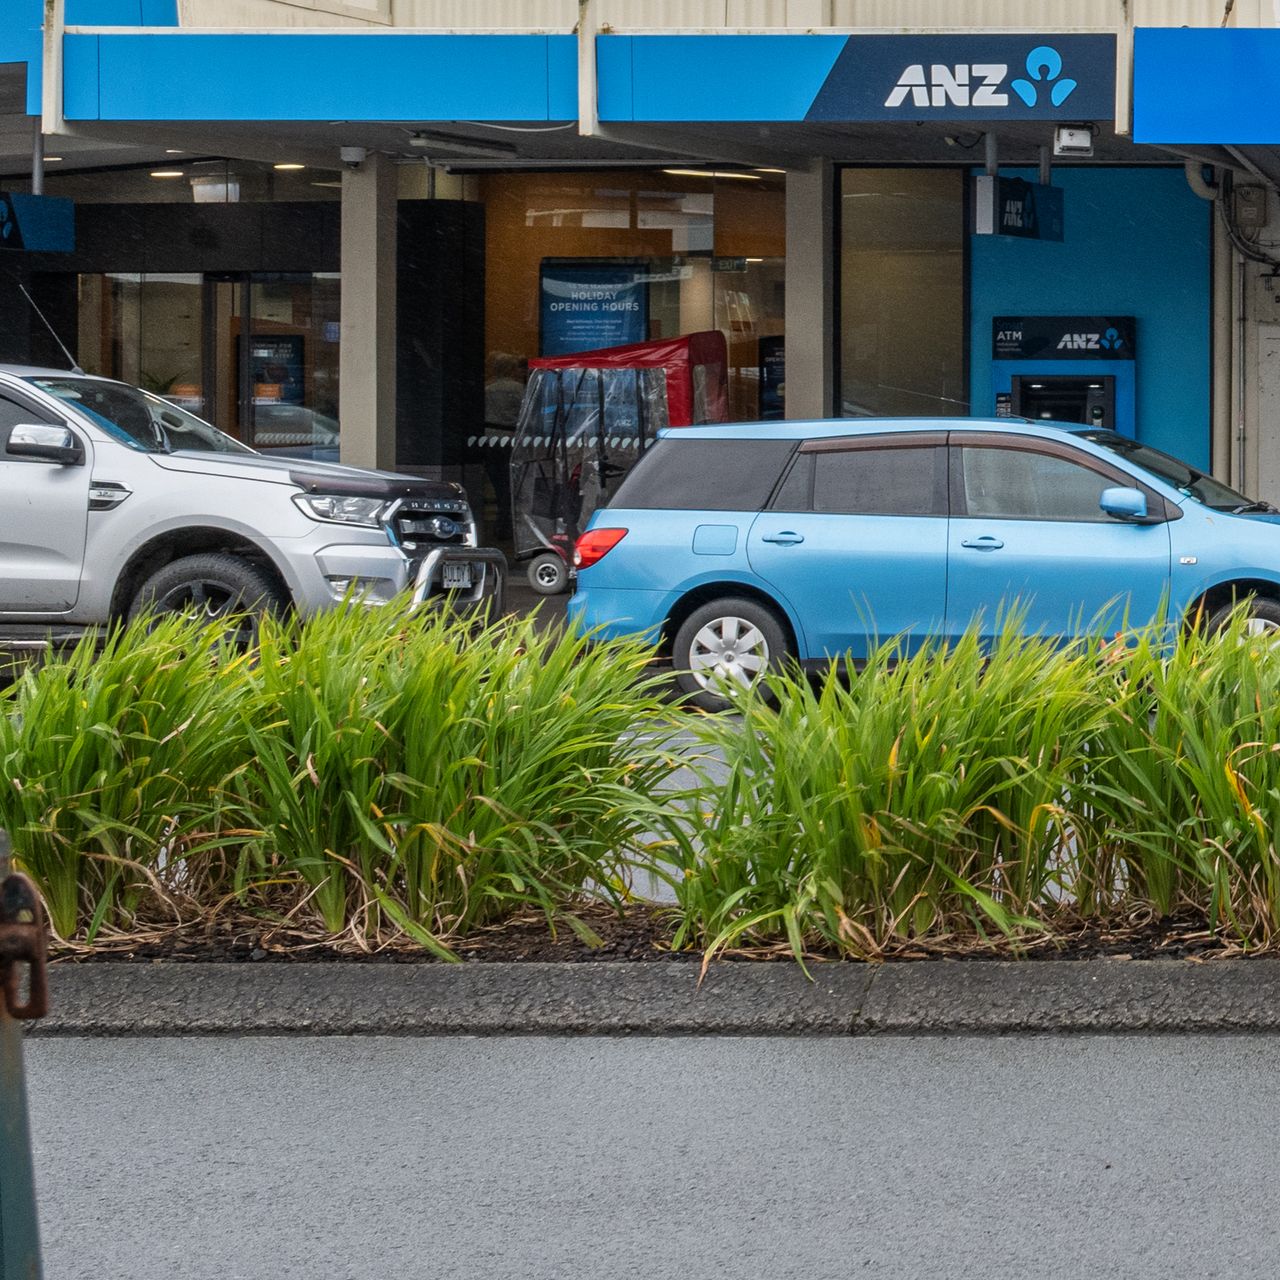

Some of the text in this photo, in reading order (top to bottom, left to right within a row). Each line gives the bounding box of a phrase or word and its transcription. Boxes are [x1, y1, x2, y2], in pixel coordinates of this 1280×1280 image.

[884, 64, 1009, 108] ANZ
[1003, 200, 1023, 228] ANZ
[719, 261, 737, 270] EXIT
[571, 291, 618, 301] HOLIDAY
[550, 302, 640, 312] OPENING HOURS
[996, 331, 1023, 341] ATM
[1057, 334, 1100, 349] ANZ
